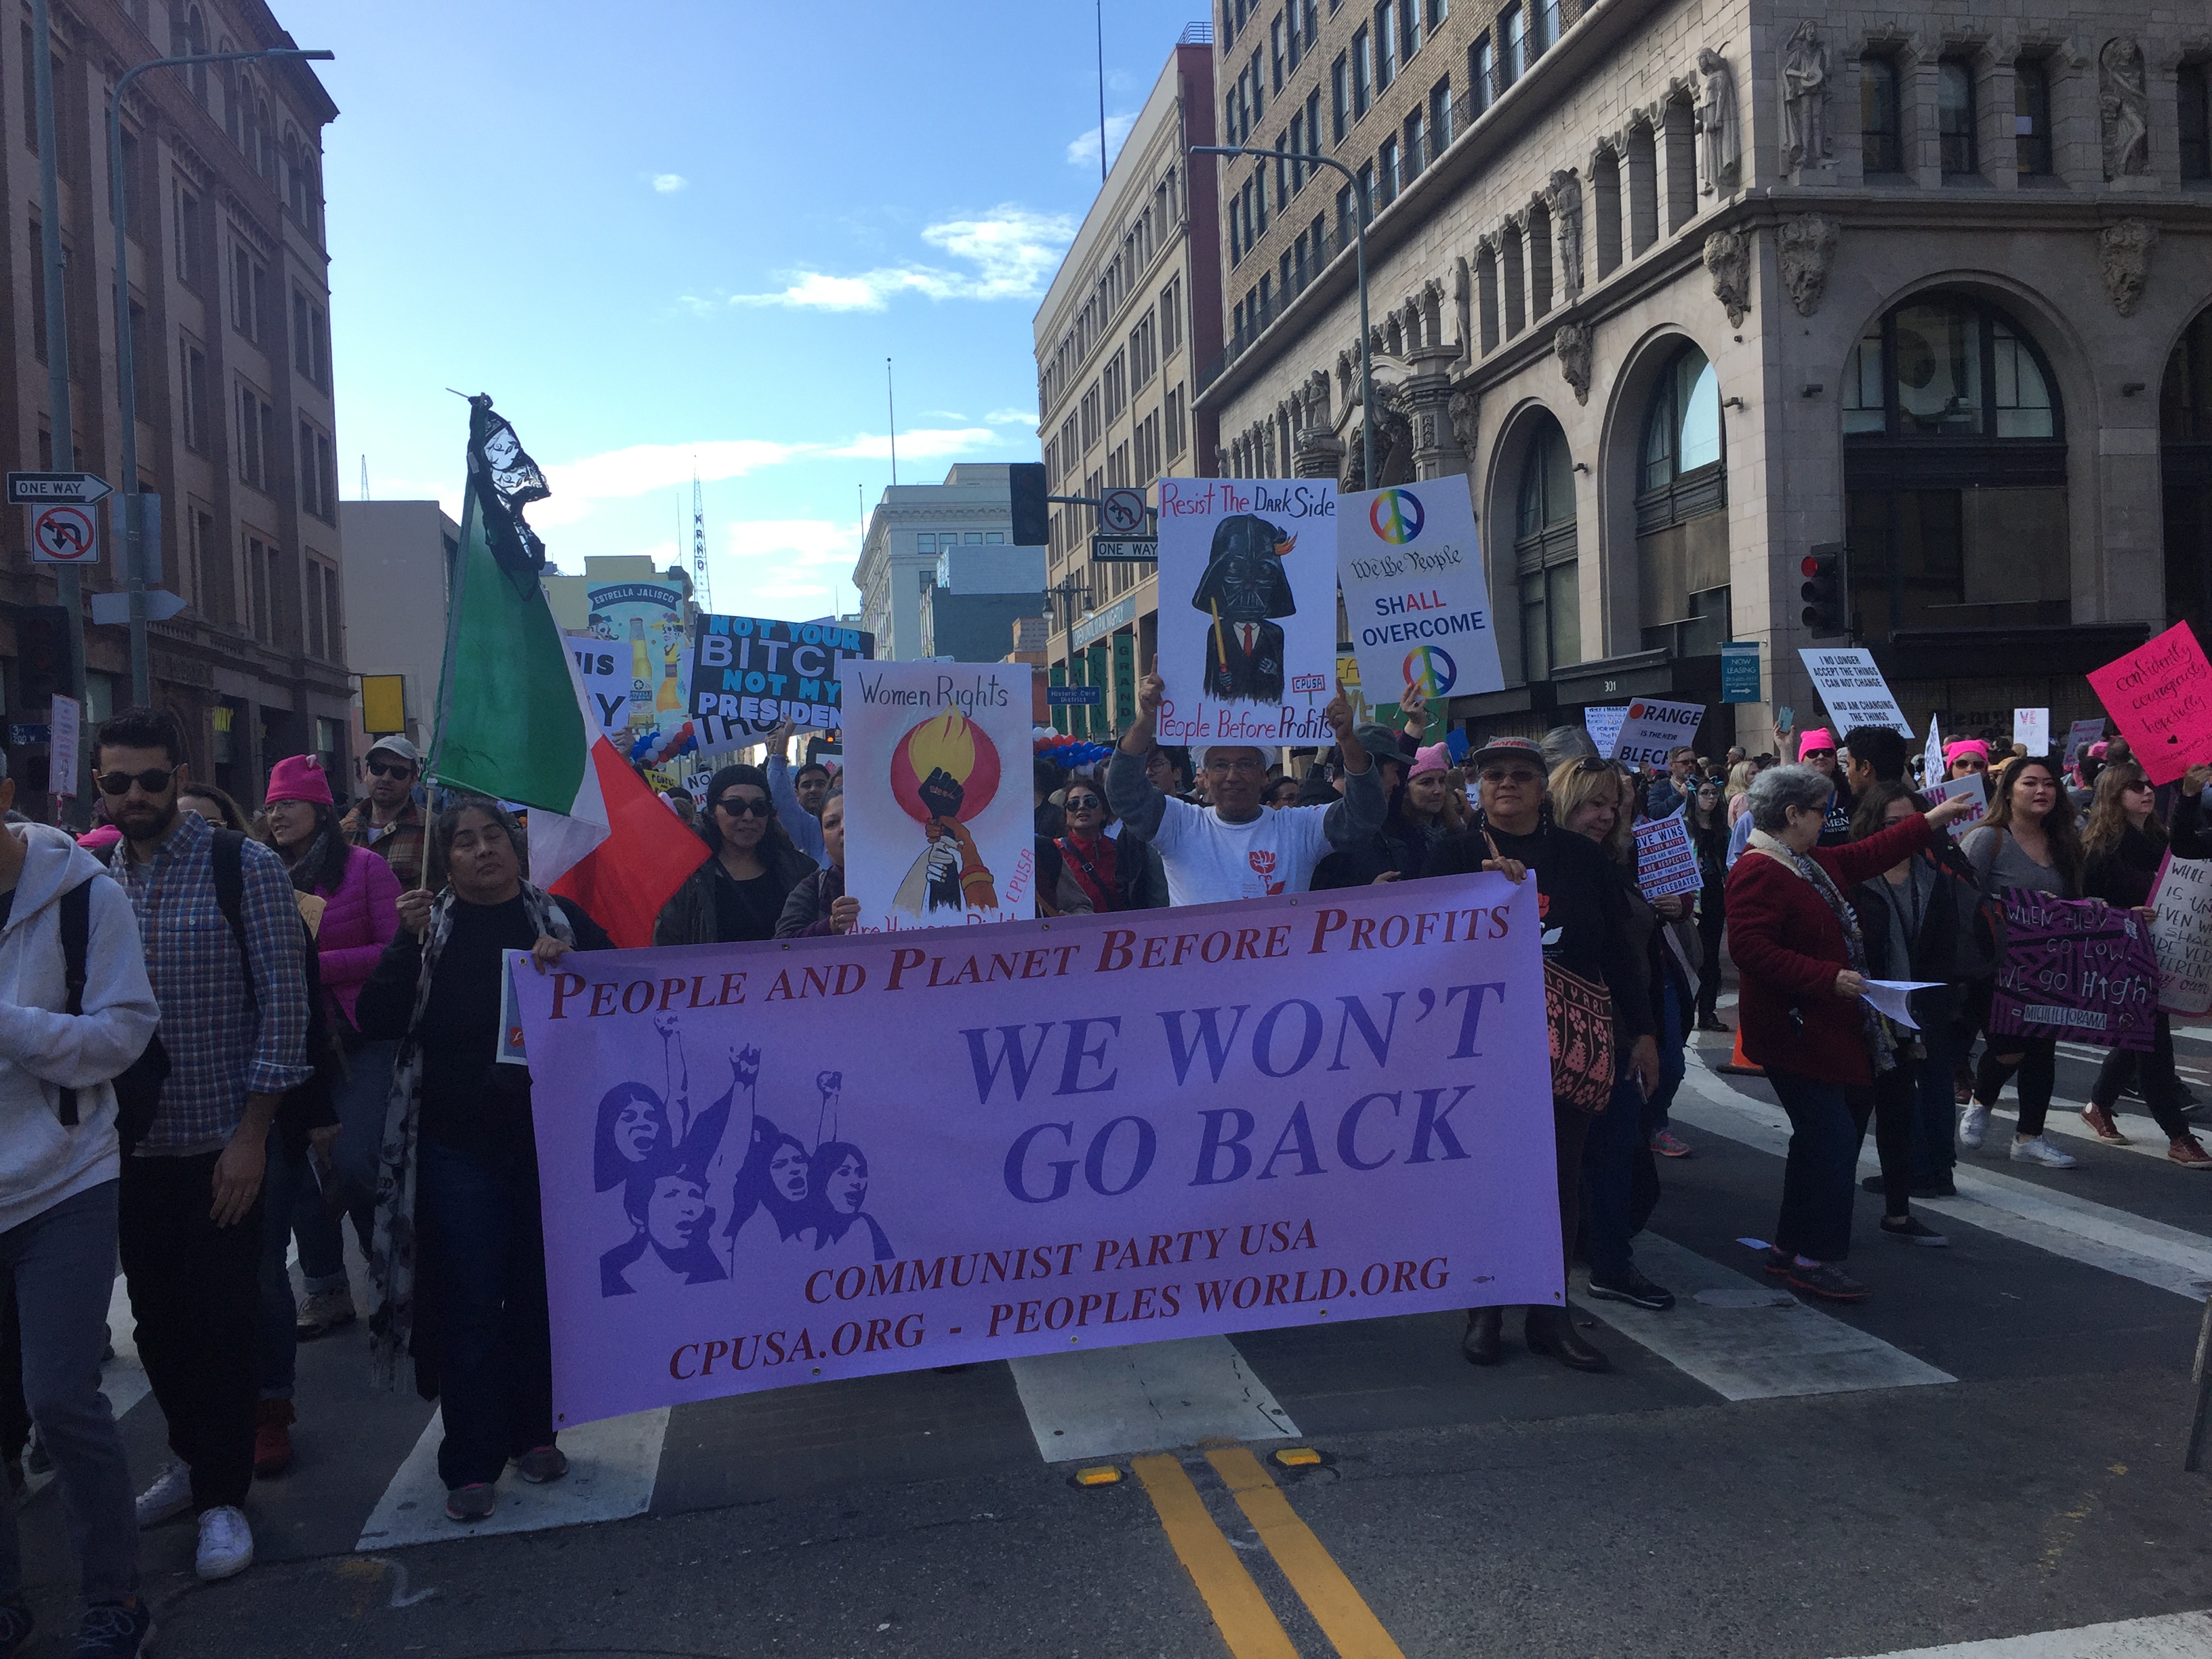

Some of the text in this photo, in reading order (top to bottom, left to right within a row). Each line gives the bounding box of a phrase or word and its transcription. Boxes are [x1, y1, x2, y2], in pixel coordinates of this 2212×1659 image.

[19, 483, 81, 494] ONE WAY
[1162, 482, 1215, 518] Resist
[1220, 484, 1250, 513] The
[1288, 486, 1336, 518] Side
[1098, 543, 1158, 556] ONE WAY
[1403, 544, 1464, 576] People
[594, 588, 675, 605] ESTRELLA JALISCO
[1374, 590, 1447, 617] SHALL
[710, 615, 861, 651] NOT YOUR
[1361, 610, 1486, 647] OVERCOME
[1812, 666, 1879, 676] ACCEPT THE THINGS
[1818, 655, 1862, 665] I NO LONGER
[722, 668, 842, 703] NOT MY
[1118, 646, 1131, 717] GRAND
[1294, 677, 1323, 690] CPUSA
[1604, 680, 1616, 693] 301
[1820, 678, 1883, 688] I CAN NOT CHANGE
[858, 672, 930, 707] Women
[937, 674, 1009, 718] Rights
[1832, 700, 1895, 711] AND AM CHANGING
[698, 691, 842, 730] PRESIDEN
[1160, 699, 1334, 745] People Before Profits
[1849, 712, 1889, 722] THE THINGS
[12, 735, 27, 743] 200
[1649, 731, 1661, 739] THE
[1662, 733, 1679, 741] NEW
[1636, 819, 1679, 836] PEOPLE ARE EQUAL
[1636, 825, 1684, 848] OVE WINS
[1638, 838, 1685, 857] ACK LIVES MATTER
[1658, 851, 1667, 859] ARE
[1667, 844, 1689, 856] WELCOME
[1643, 863, 1656, 874] ARE
[1658, 853, 1691, 869] RESPECTED
[2172, 862, 2208, 884] WHILE
[1005, 848, 1036, 904] CPUSA
[1645, 875, 1700, 898] IS CELEBRATED
[2166, 886, 2184, 901] IS
[2007, 904, 2053, 927] WHEN
[2157, 903, 2193, 928] EVEN
[2047, 939, 2072, 954] GO
[548, 905, 1511, 1020] PEOPLE AND PLANET BEFORE PROFITS
[1998, 965, 2030, 992] WE
[2025, 1006, 2107, 1030] MICHELLE OBAMA
[958, 981, 1507, 1107] WE WON'T
[1002, 1084, 1477, 1205] GO BACK
[804, 1217, 1320, 1305] COMMUNIST PARTY USA
[669, 1256, 1453, 1380] CPUSA.ORG PEOPLES WORLD.ORG
